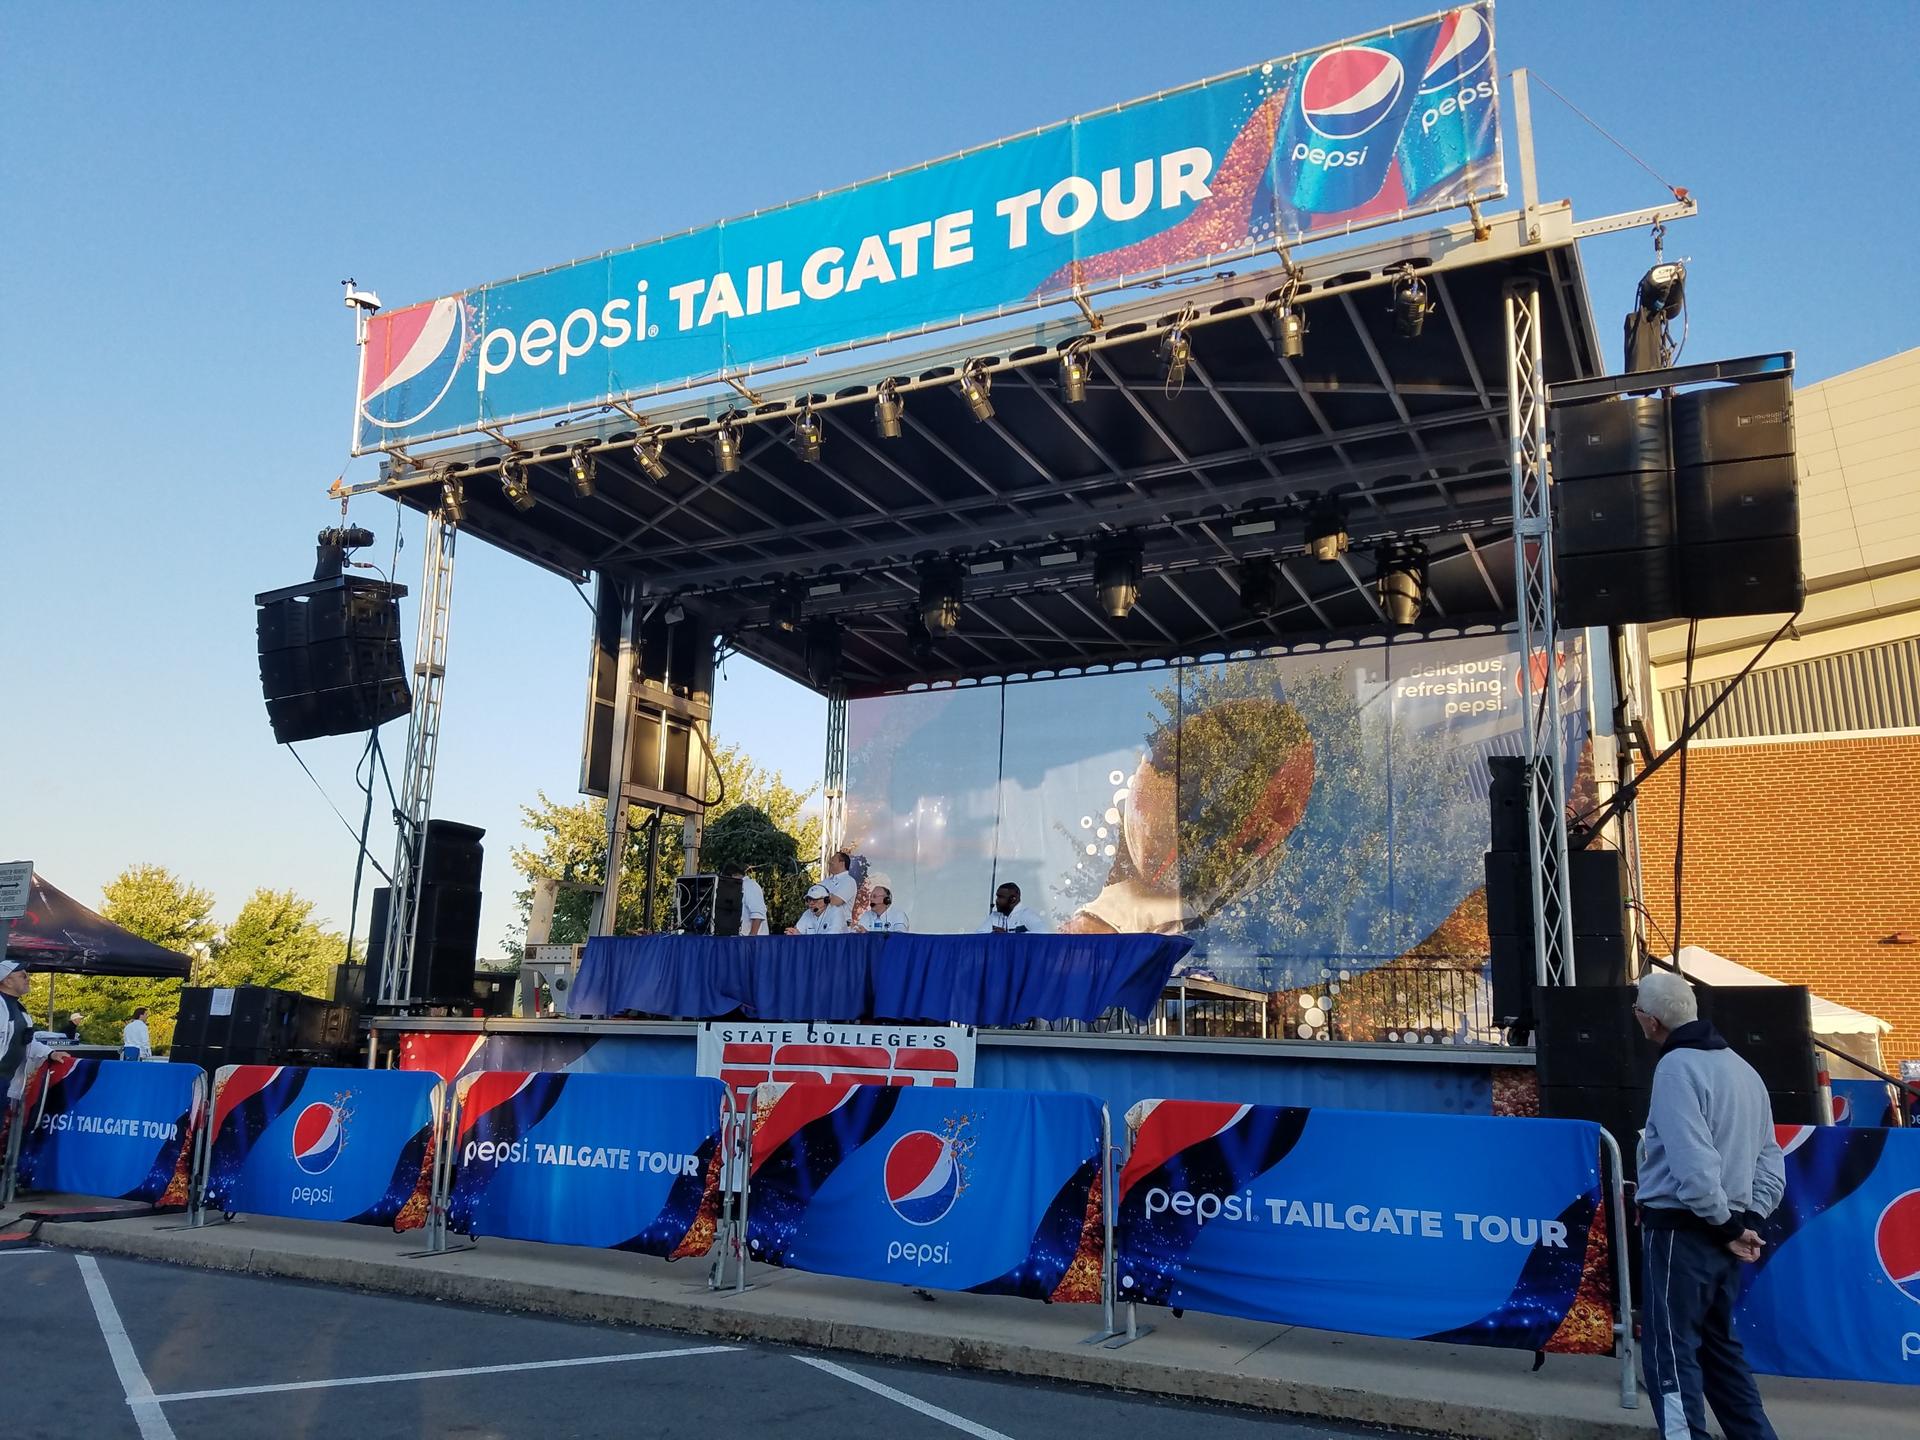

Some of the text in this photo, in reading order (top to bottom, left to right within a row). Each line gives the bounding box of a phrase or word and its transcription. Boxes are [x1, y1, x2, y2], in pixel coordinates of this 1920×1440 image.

[1420, 76, 1499, 134] pepsi
[1291, 142, 1368, 171] pepsi
[478, 146, 1214, 392] pepsi TAILGATE TOUR
[1410, 658, 1506, 678] delicious.
[1397, 677, 1507, 698] refreshing.
[1445, 698, 1507, 718] pepsi.
[722, 1030, 947, 1048] STATE COLLEGE'S
[40, 1110, 178, 1142] epsi TAILGATE TOUR
[464, 1137, 700, 1177] pepsi TAILGATE TOUR
[291, 1185, 333, 1206] pepsi
[1145, 1187, 1569, 1248] pepsi TAILGATE TOUR
[887, 1240, 951, 1266] pepsi
